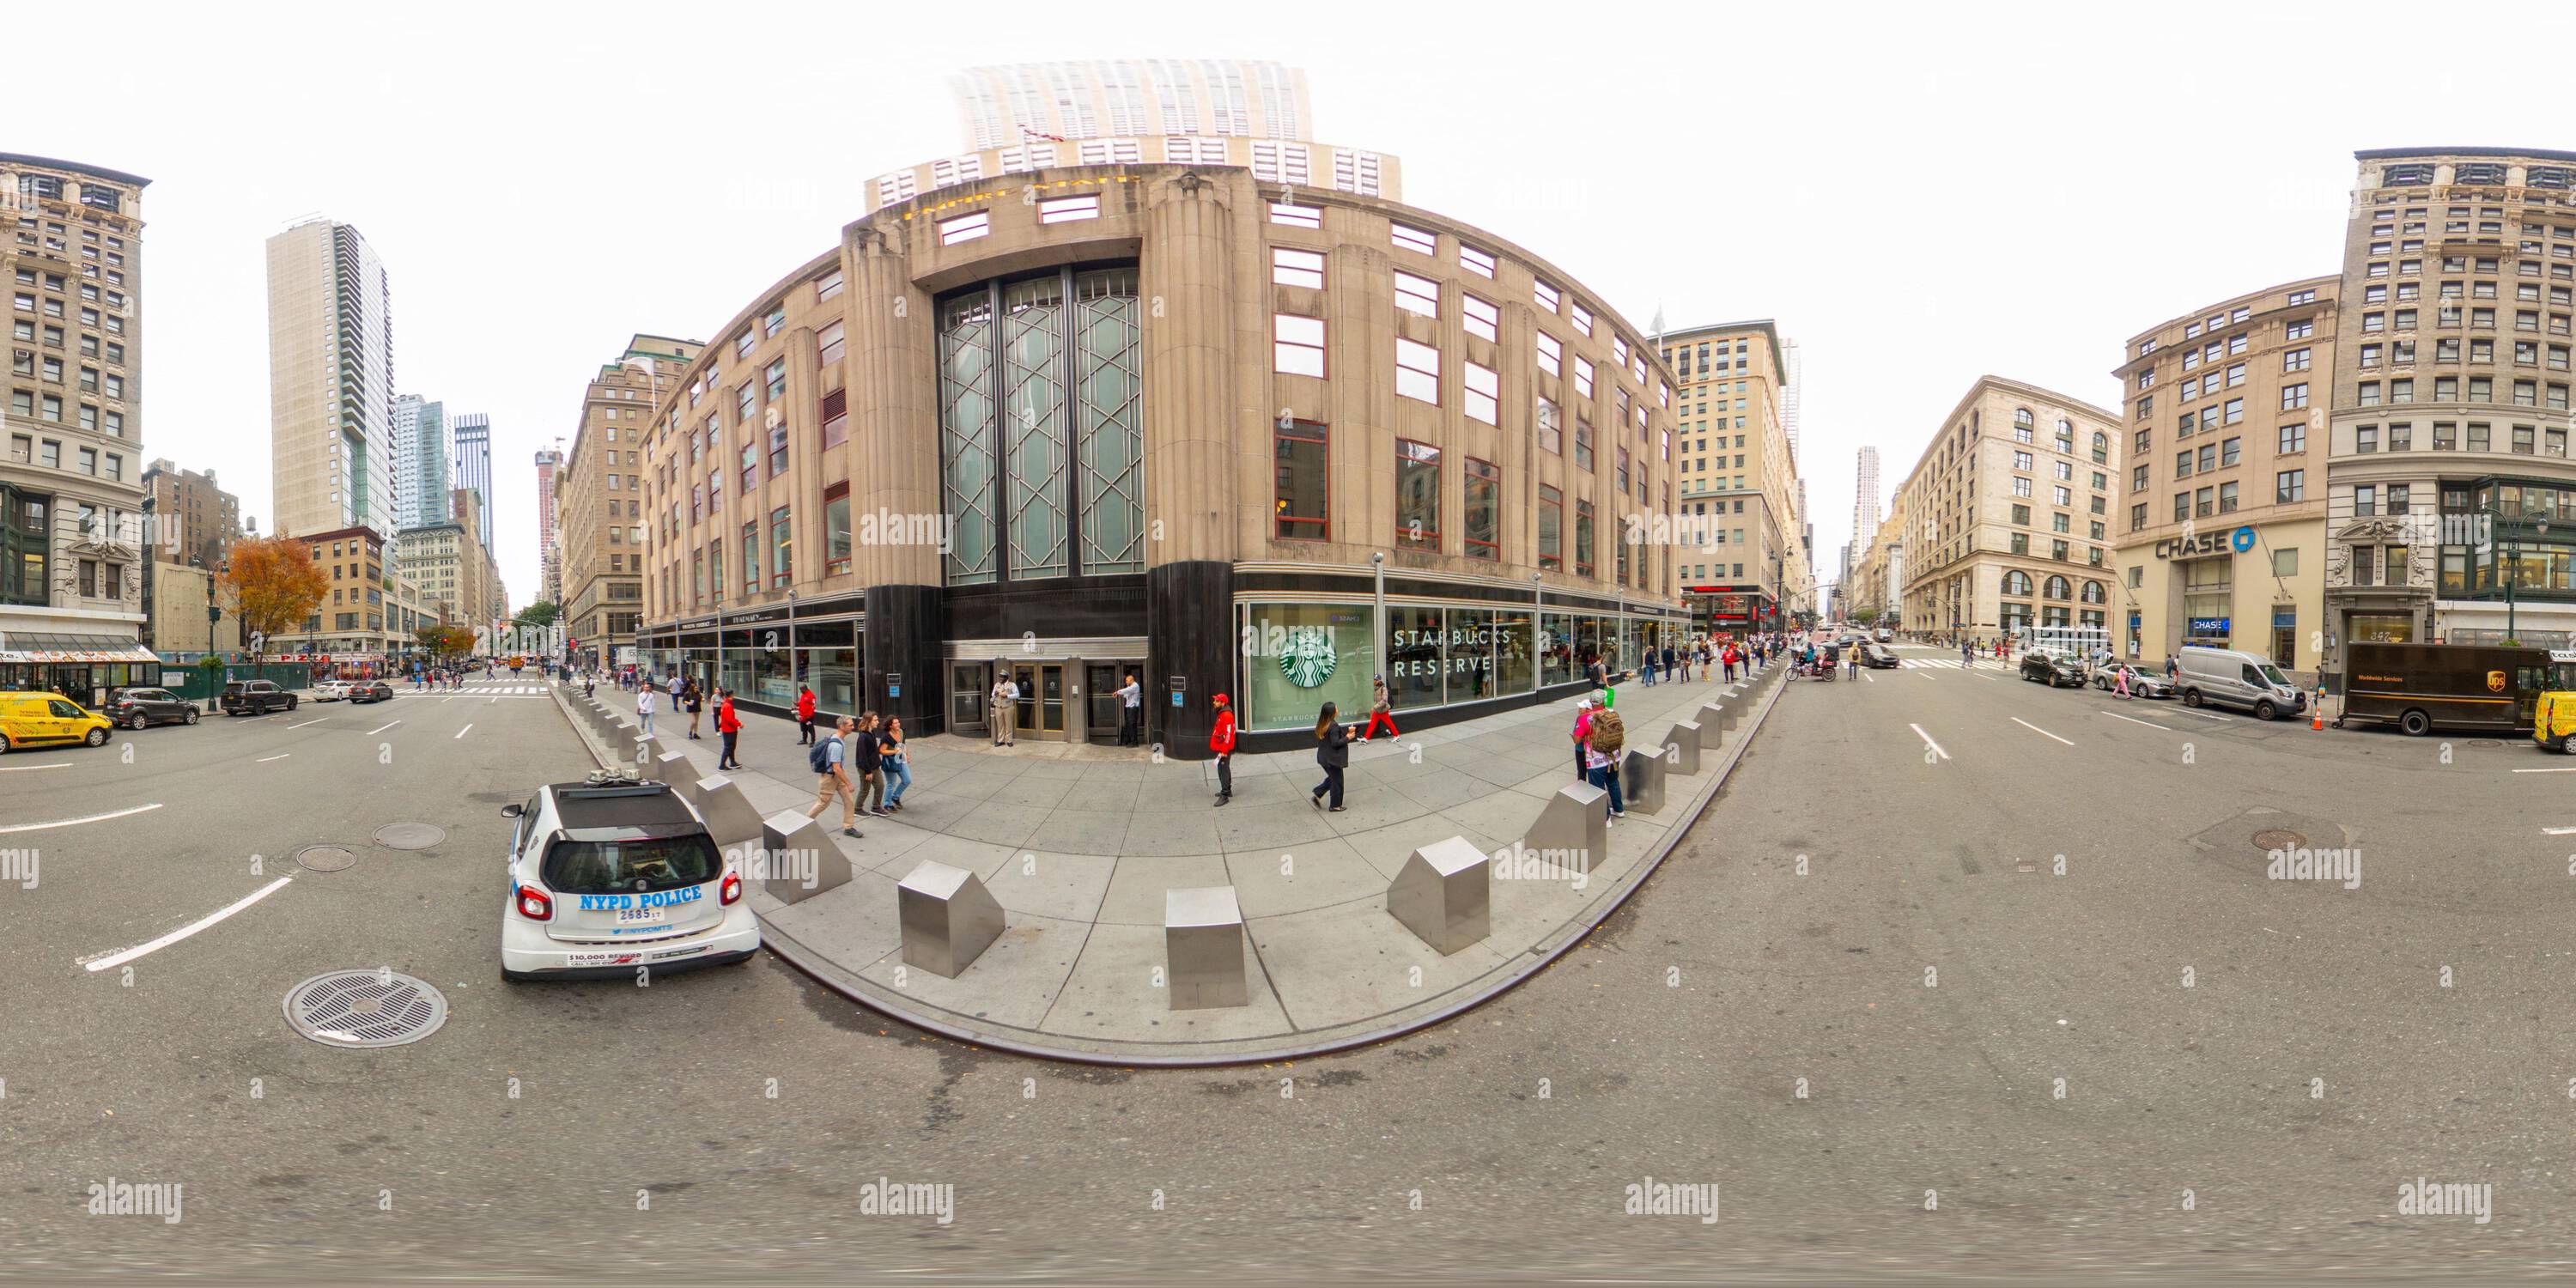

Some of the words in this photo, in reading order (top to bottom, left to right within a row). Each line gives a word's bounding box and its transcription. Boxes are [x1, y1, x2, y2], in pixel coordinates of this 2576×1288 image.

[2155, 531, 2228, 559] CHASE
[2195, 621, 2222, 629] CHASE
[1394, 630, 1510, 646] STARBUCKS
[1394, 657, 1491, 677] RESERVE
[2488, 676, 2505, 690] ups
[580, 895, 632, 910] NYPD
[641, 886, 702, 909] POLICE
